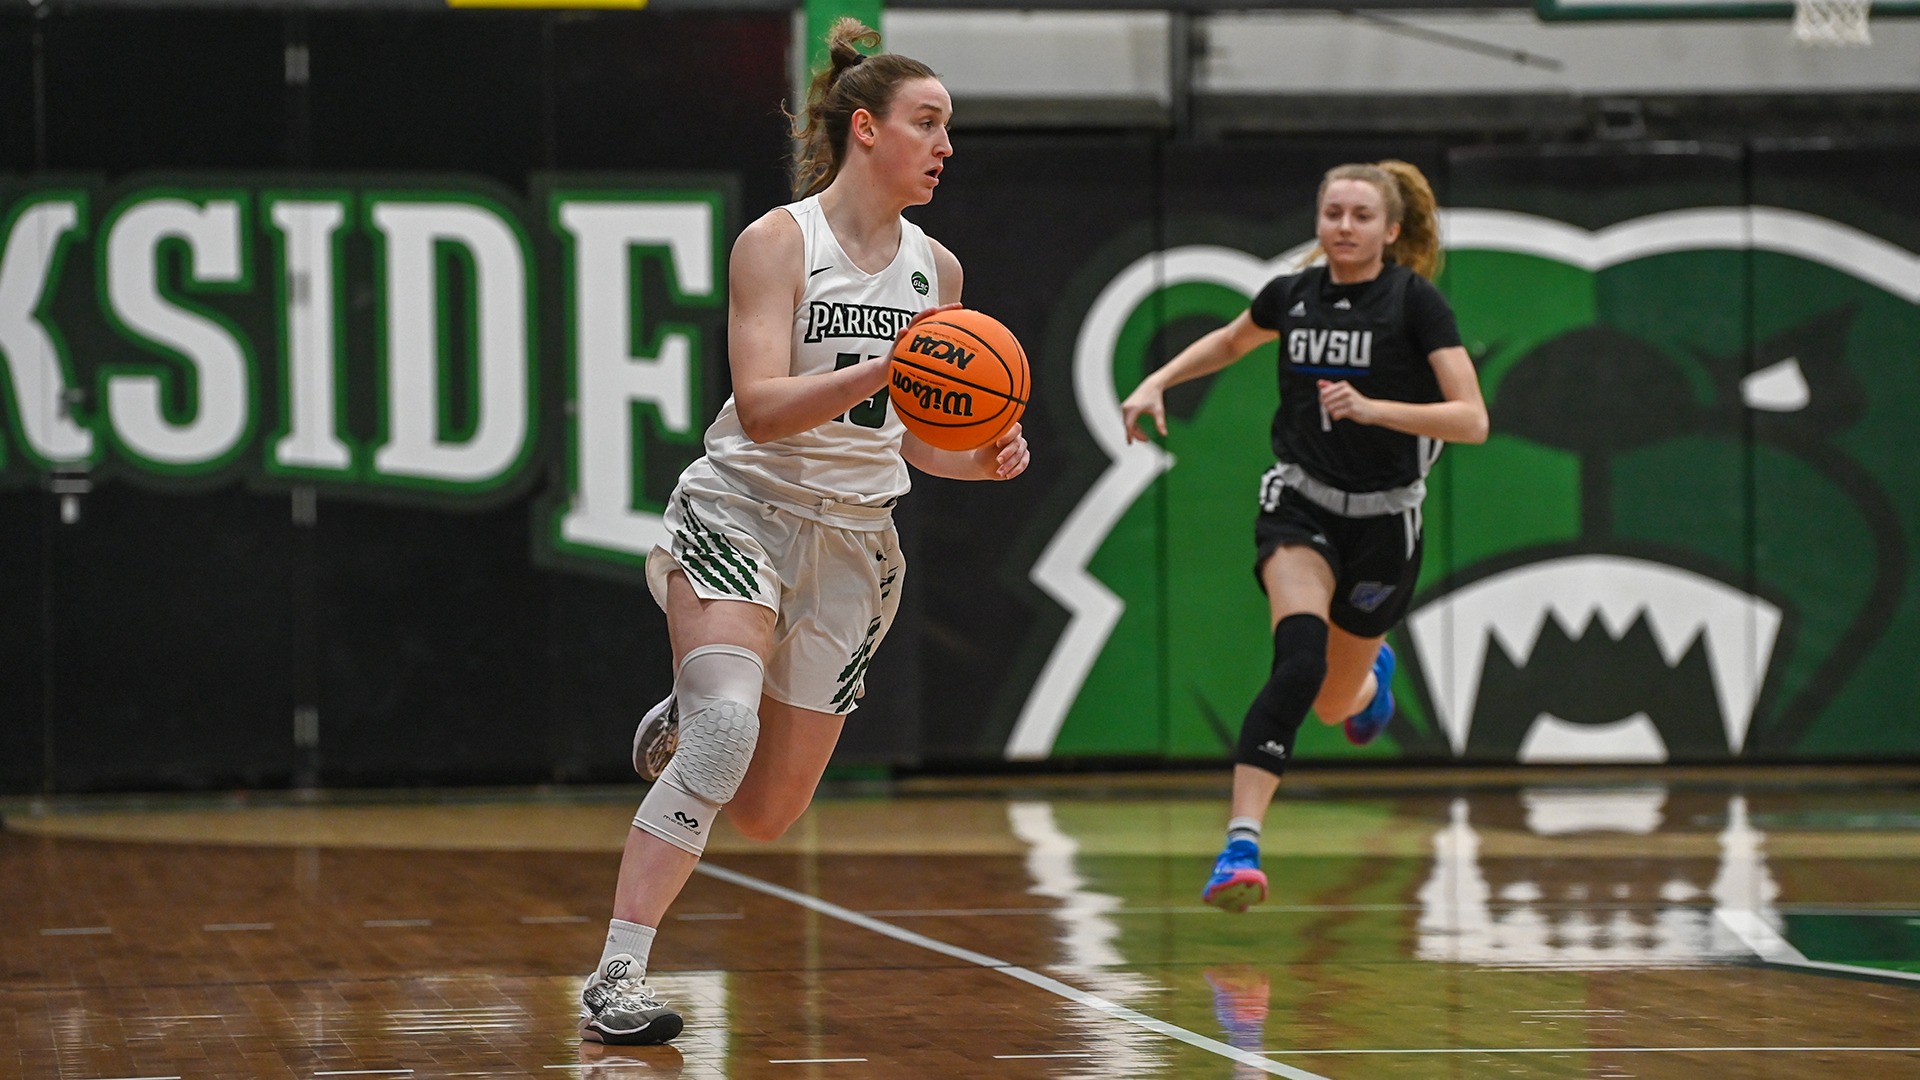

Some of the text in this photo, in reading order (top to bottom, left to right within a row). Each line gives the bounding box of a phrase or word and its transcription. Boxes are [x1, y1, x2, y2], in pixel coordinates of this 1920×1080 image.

[804, 301, 918, 343] PARKSID
[908, 334, 976, 371] NCAA
[1288, 327, 1373, 368] GVSU
[892, 367, 973, 417] Wilson
